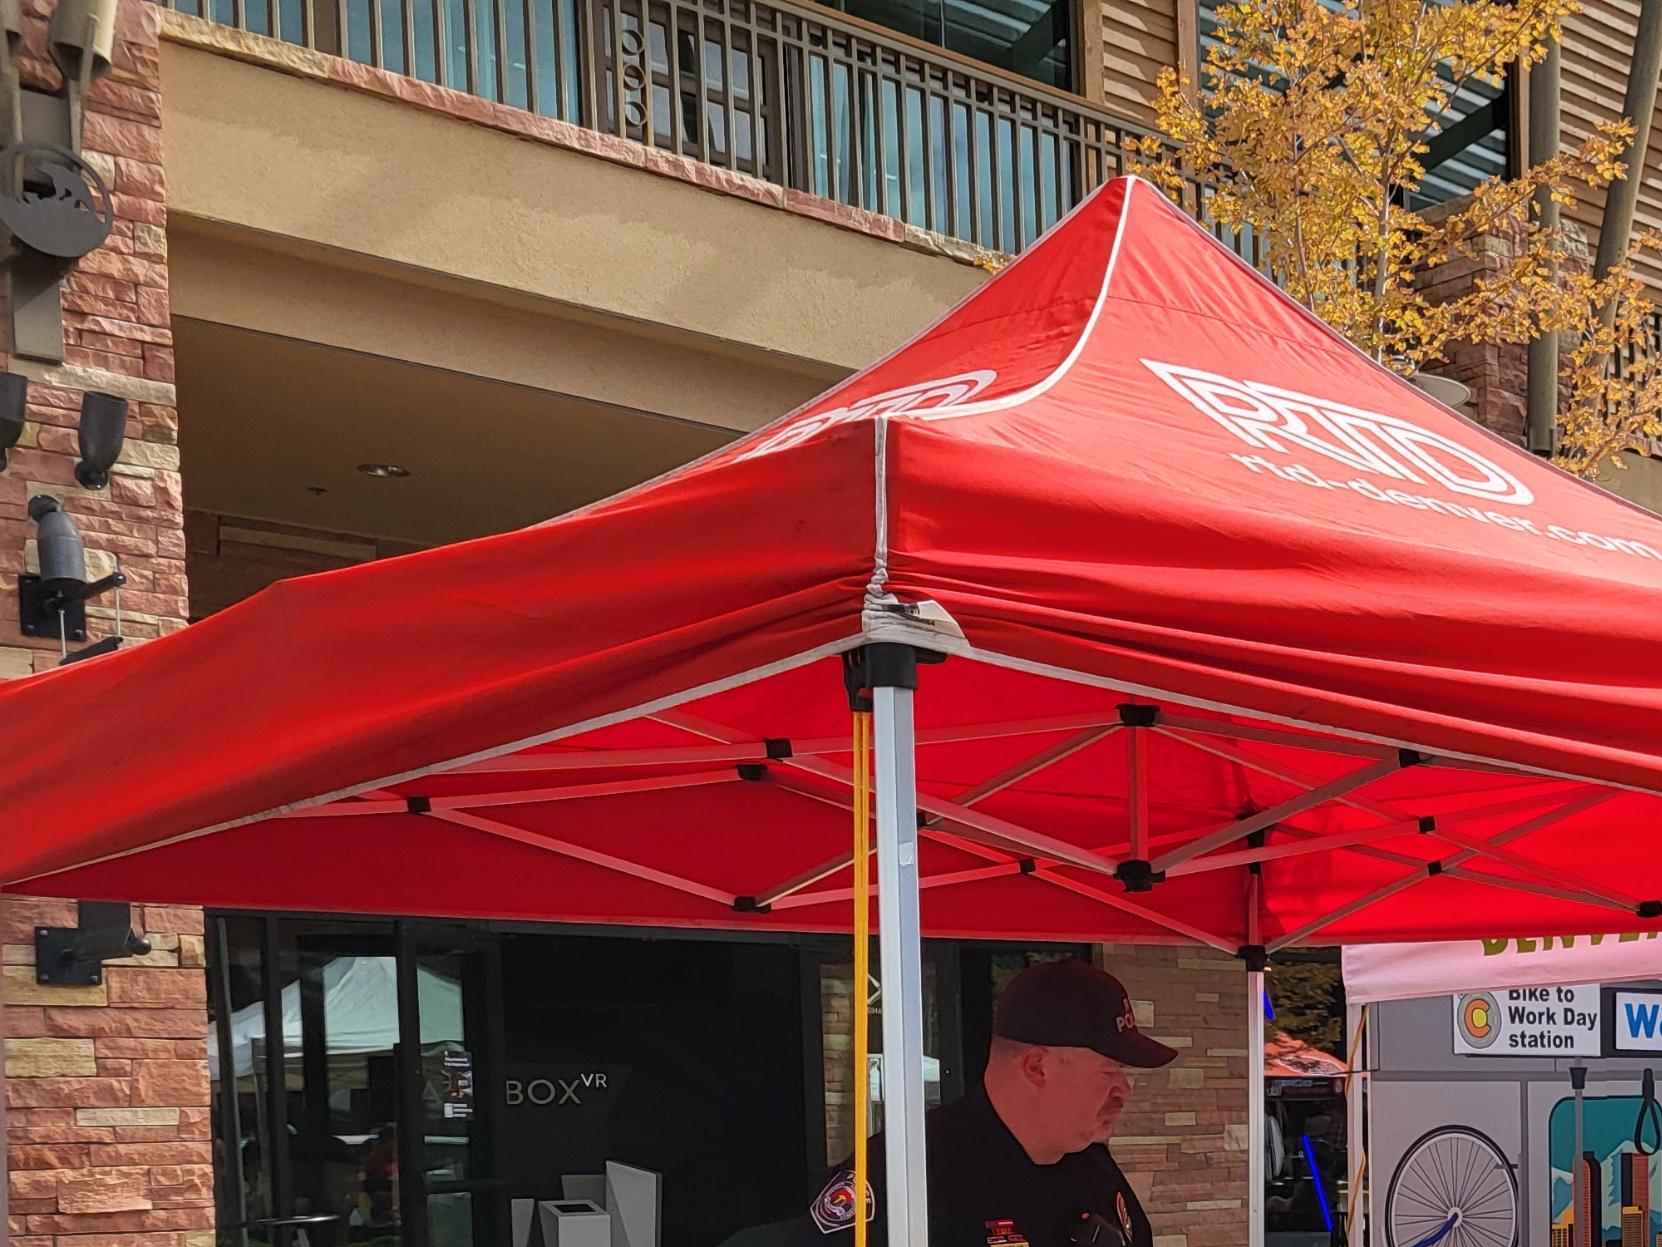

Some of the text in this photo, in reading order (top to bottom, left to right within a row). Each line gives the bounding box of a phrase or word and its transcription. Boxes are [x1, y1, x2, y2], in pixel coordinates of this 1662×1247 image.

[1140, 357, 1535, 507] RTD
[1556, 986, 1575, 1002] to
[1508, 1006, 1598, 1031] Work Day
[1508, 1030, 1575, 1049] station
[505, 1073, 608, 1105] BOX VR
